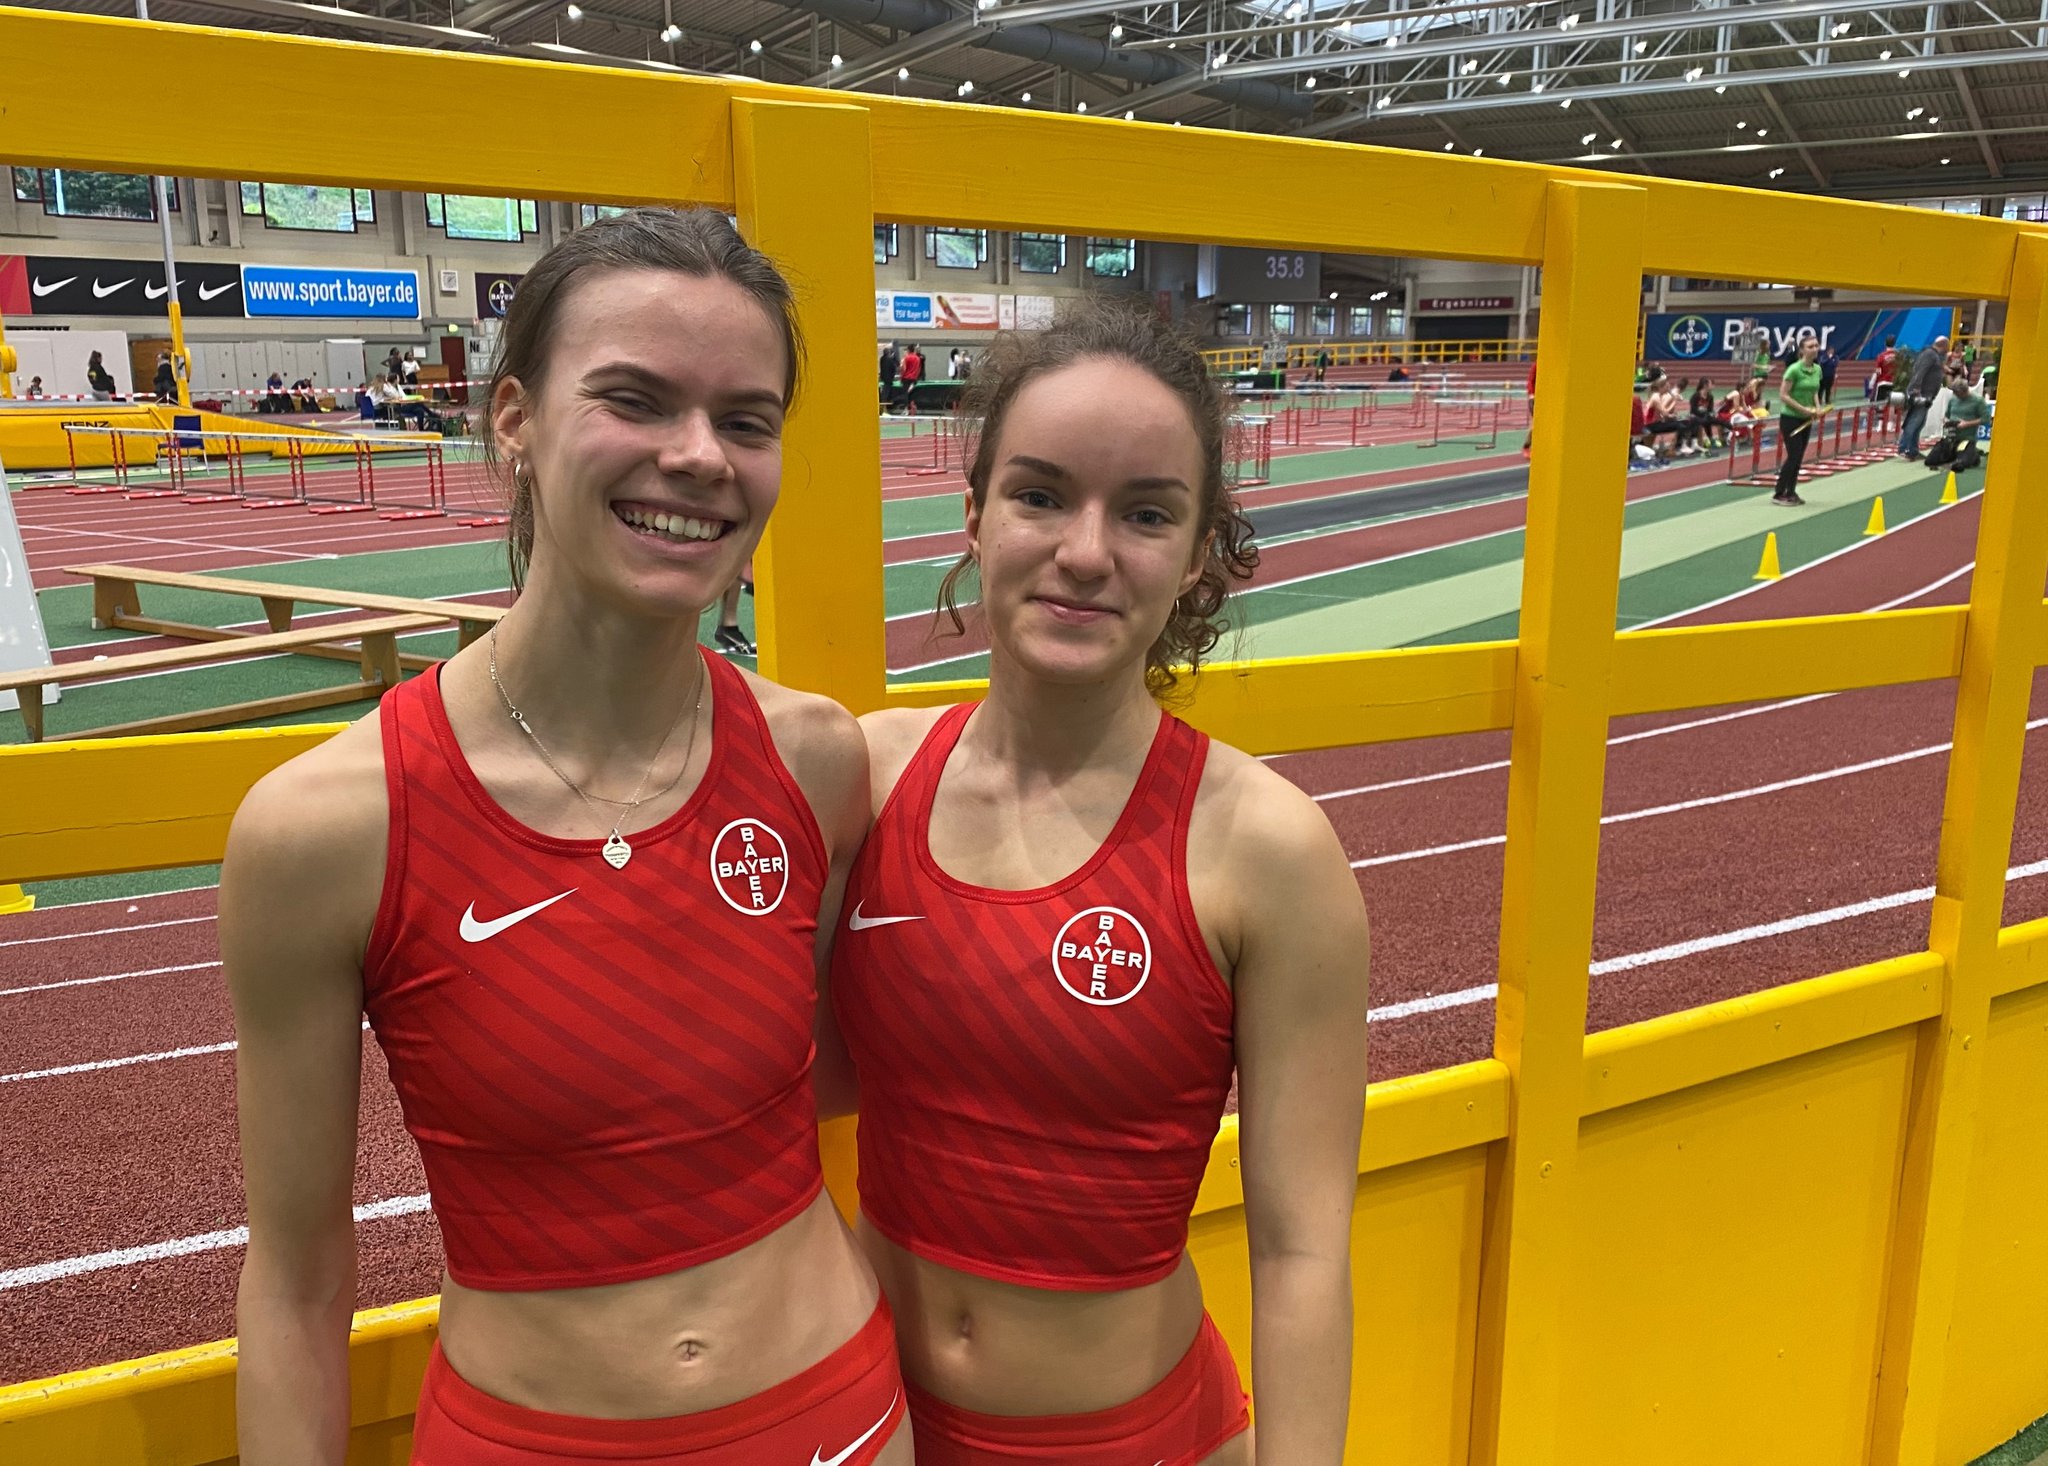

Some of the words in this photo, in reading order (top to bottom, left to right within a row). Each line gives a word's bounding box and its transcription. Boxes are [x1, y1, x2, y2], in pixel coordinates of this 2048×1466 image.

[1266, 255, 1304, 278] 35.8
[248, 279, 414, 308] www.sport.bayer.de
[1432, 299, 1500, 310] Ergebnisse
[1673, 332, 1709, 341] BAYER
[718, 857, 784, 878] BAYER
[740, 827, 766, 908] BAYER
[1061, 942, 1143, 969] BAYER
[1089, 914, 1115, 998] BAYER
